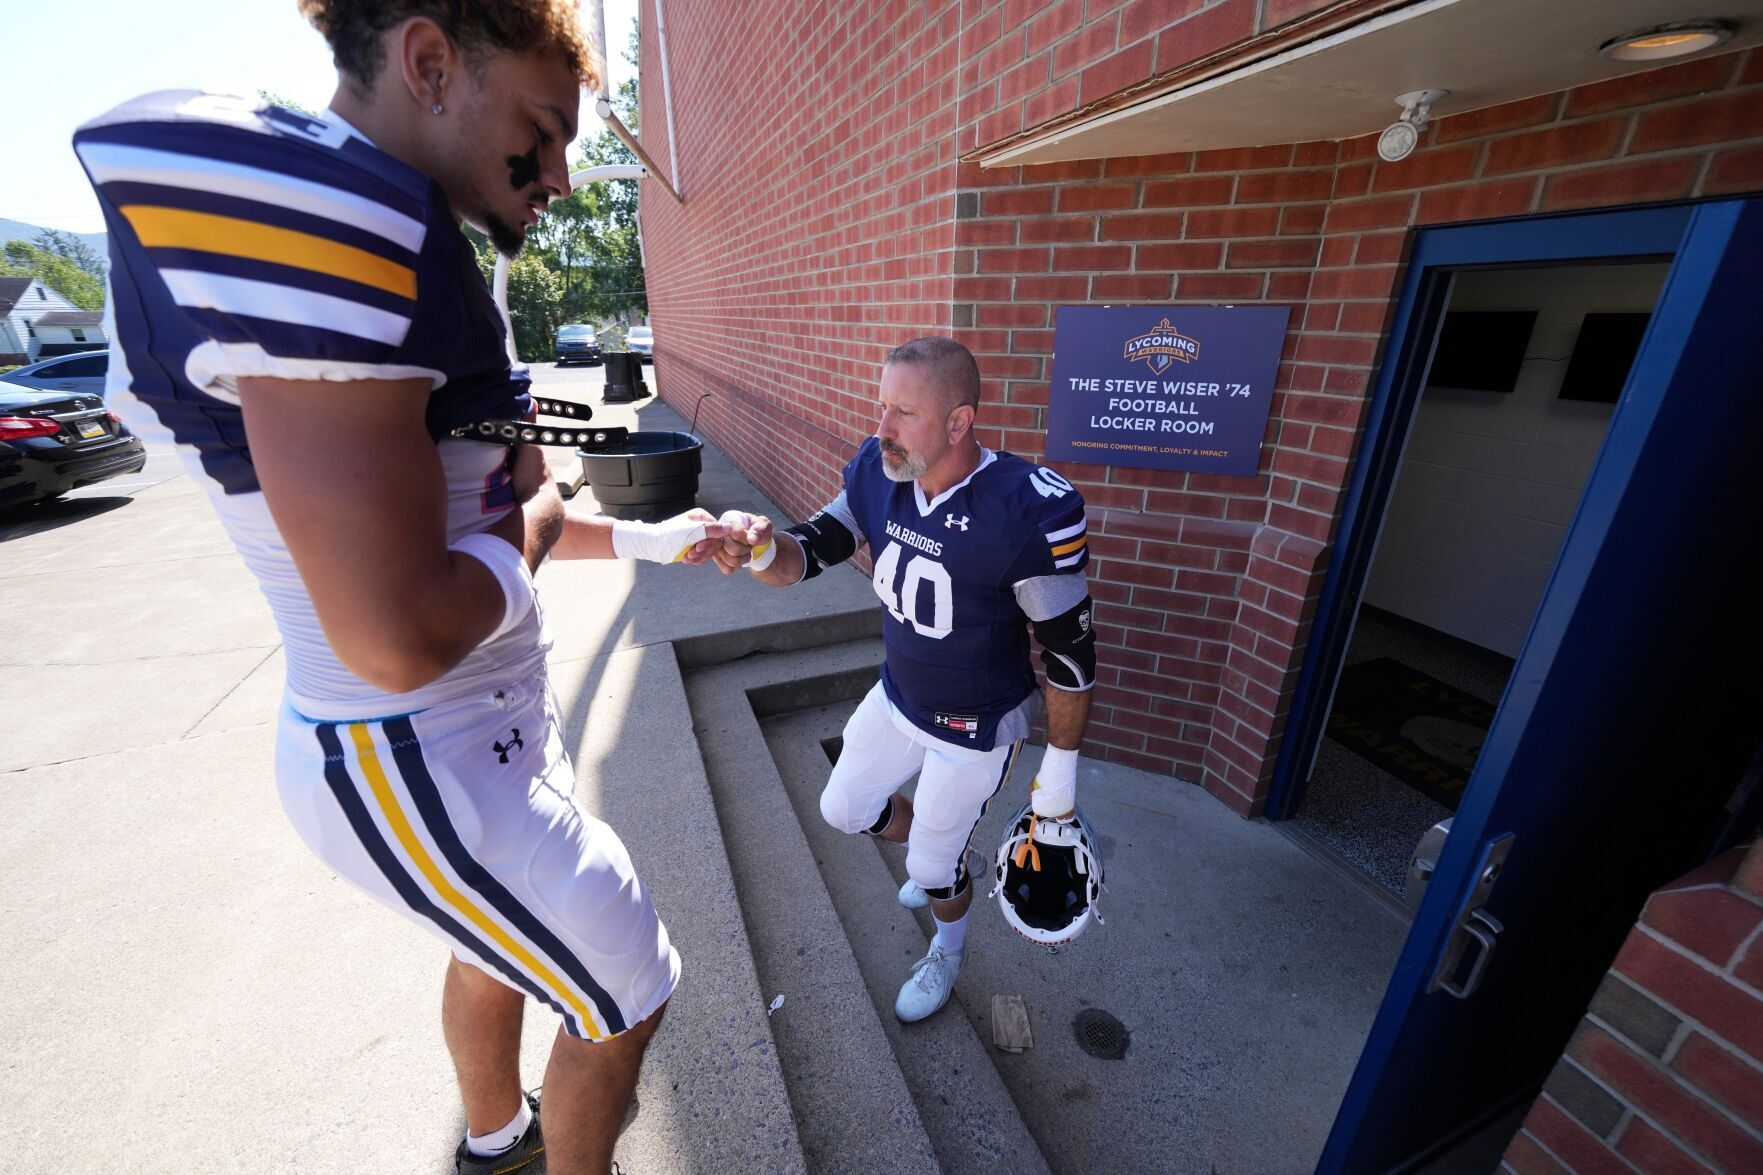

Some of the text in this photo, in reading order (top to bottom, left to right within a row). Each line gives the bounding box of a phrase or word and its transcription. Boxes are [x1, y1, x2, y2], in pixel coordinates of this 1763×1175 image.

[1128, 336, 1196, 353] LYCOMING
[1069, 378, 1251, 397] THE STEVE WISER '74
[1109, 398, 1199, 415] FOOTBALL
[1090, 415, 1215, 435] LOCKER ROOM
[1071, 440, 1109, 449] HONORING
[1110, 443, 1158, 453] COMMITMENT,
[1159, 447, 1192, 455] LOYALTY
[1200, 449, 1229, 457] IMPACT
[1028, 466, 1074, 498] 40
[885, 520, 943, 557] WARRIORS
[872, 540, 953, 640] 40
